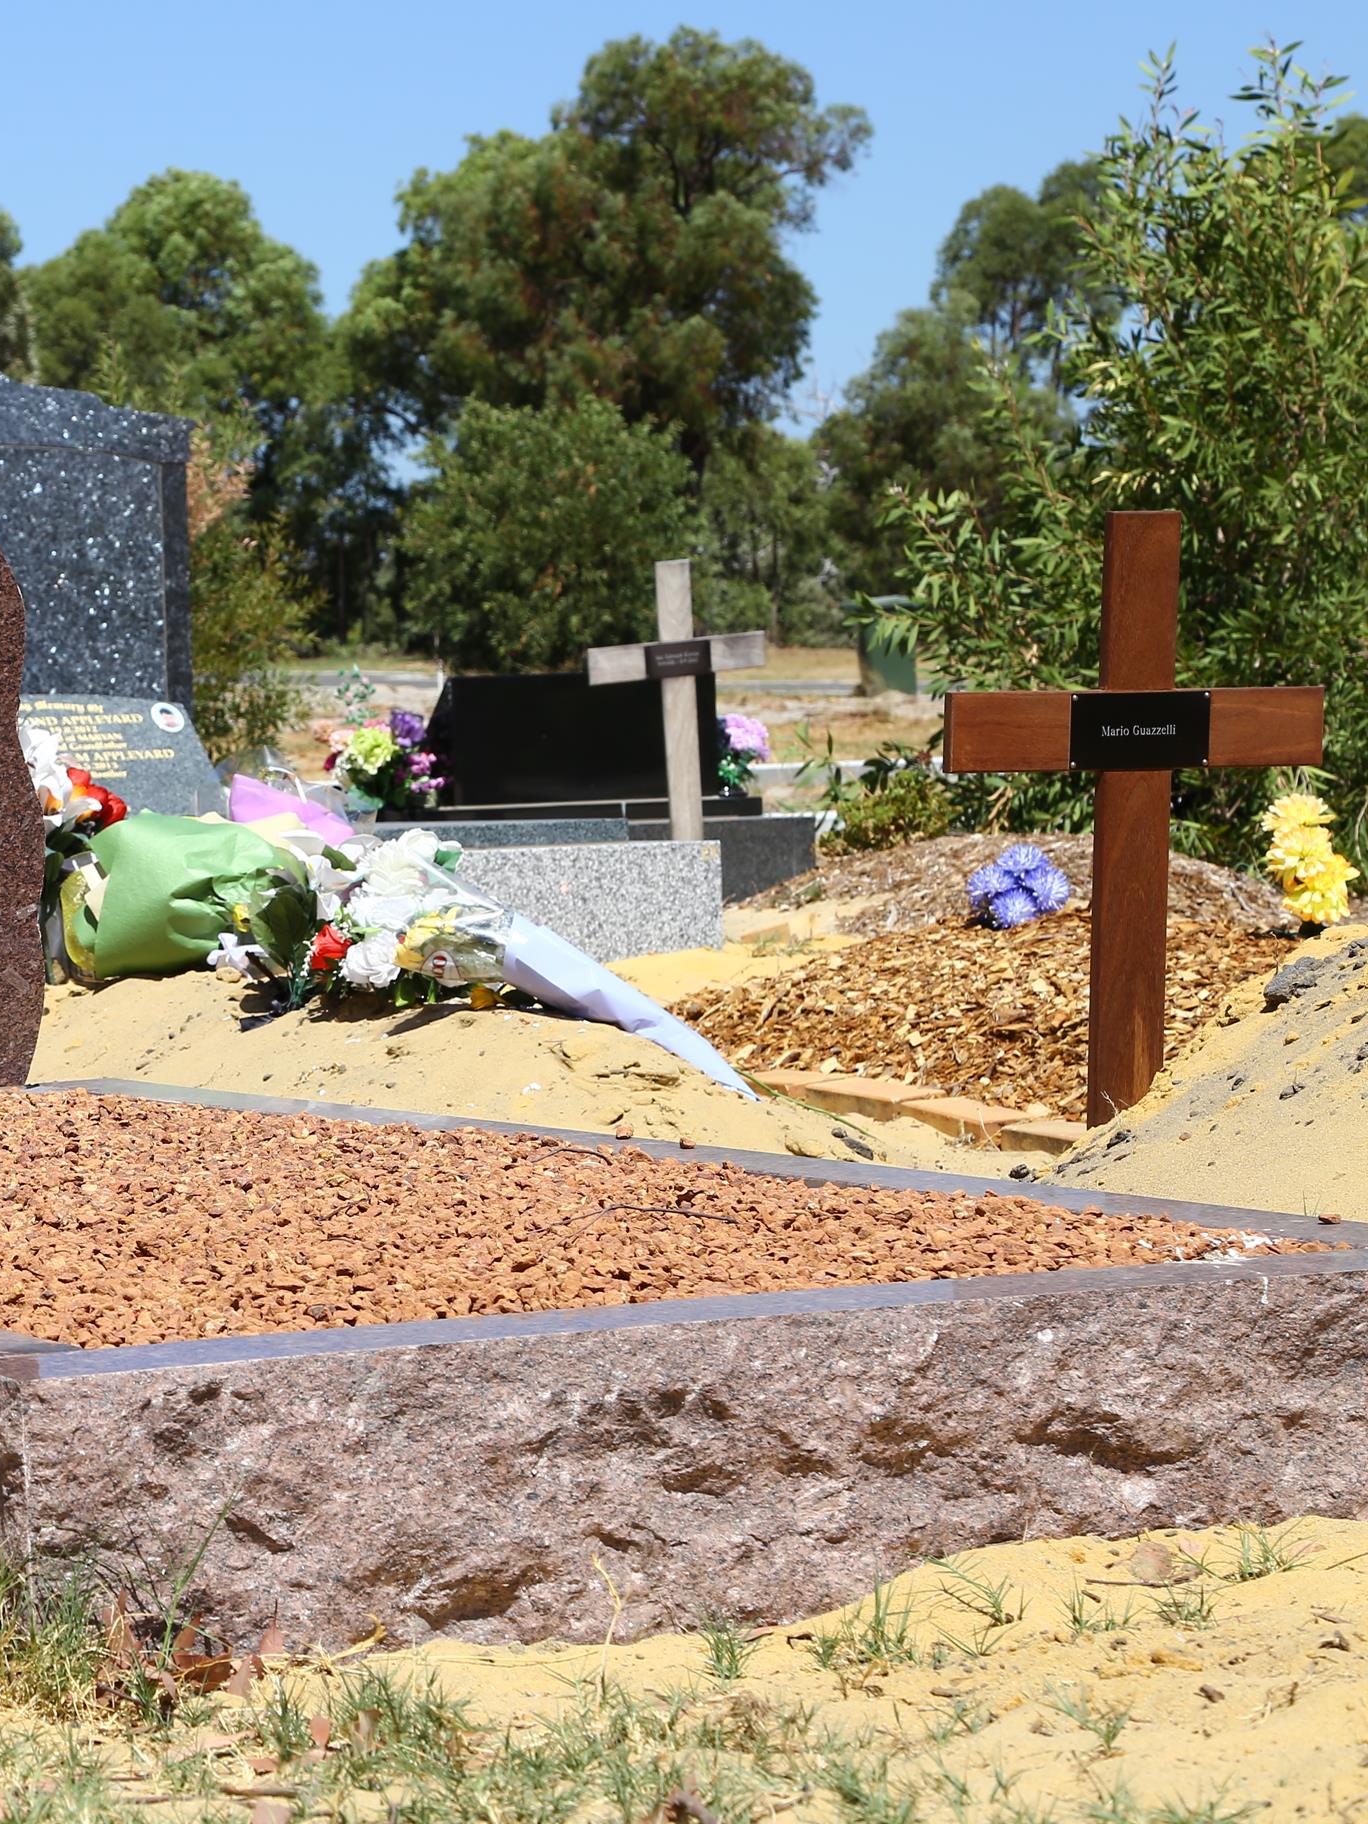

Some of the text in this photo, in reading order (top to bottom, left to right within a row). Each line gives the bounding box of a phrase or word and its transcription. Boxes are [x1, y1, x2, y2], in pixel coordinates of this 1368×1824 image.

[62, 713, 144, 726] APPLEYARD
[1101, 724, 1177, 737] Mario Guazzelli
[94, 748, 175, 762] APPLEYARD
